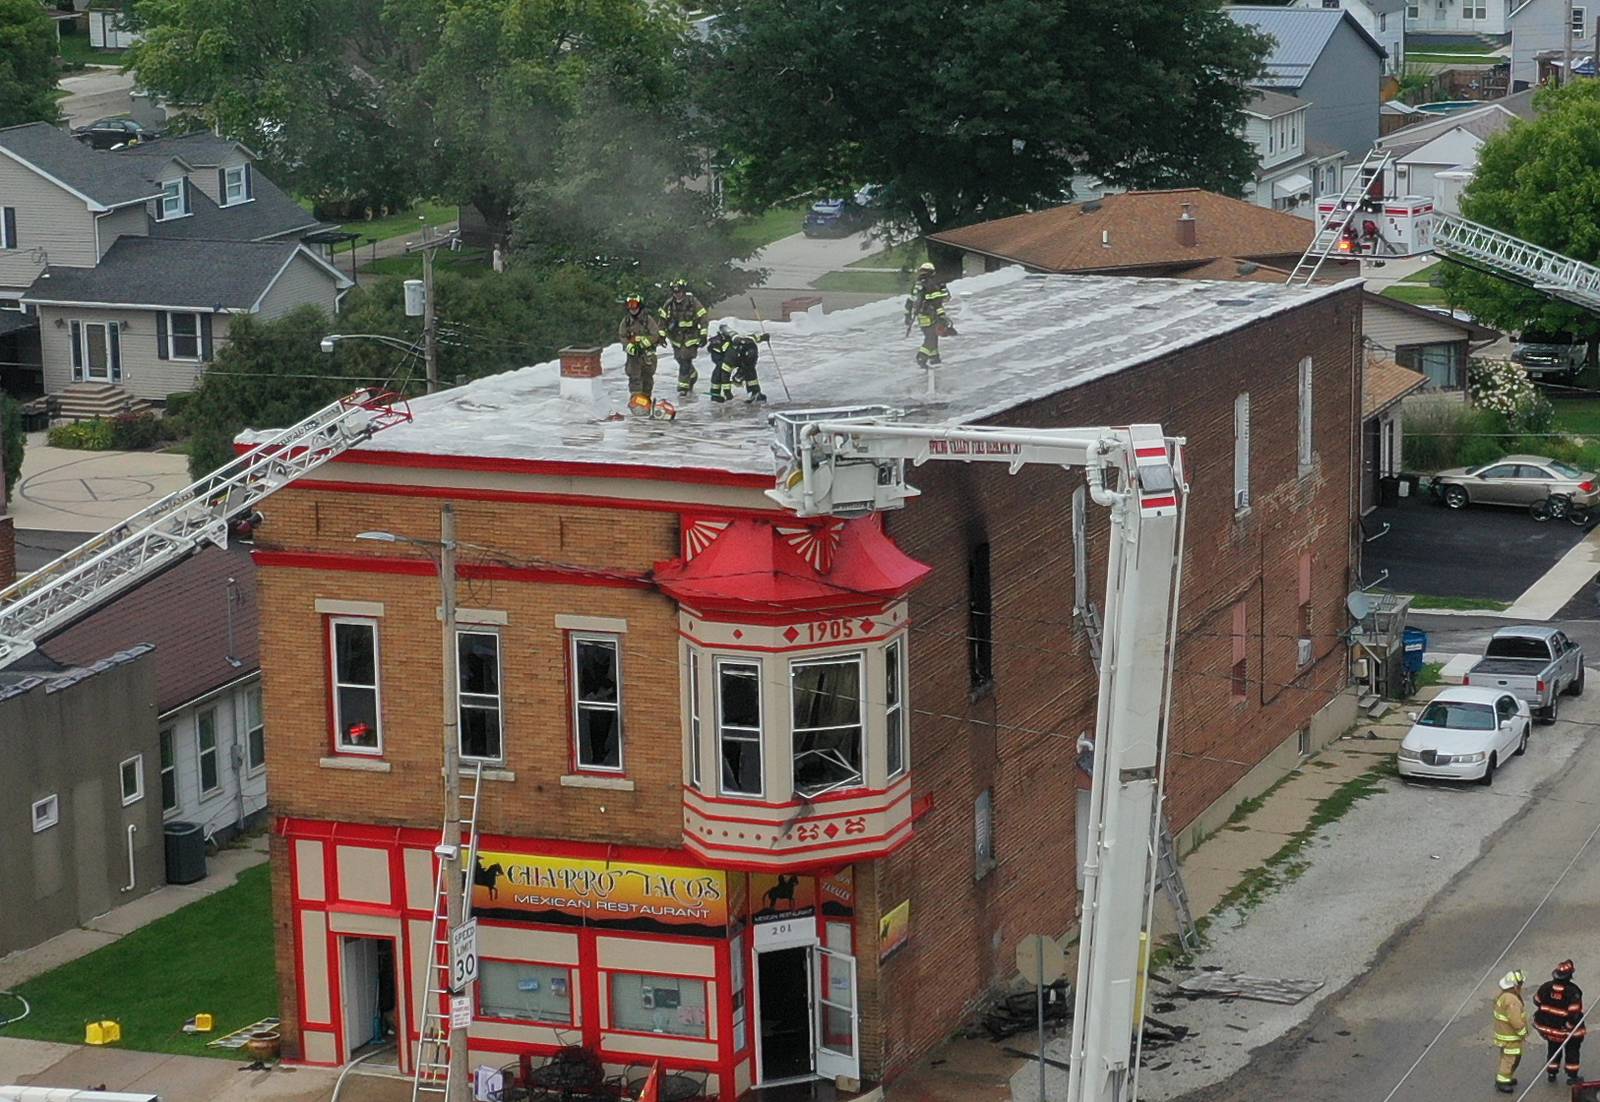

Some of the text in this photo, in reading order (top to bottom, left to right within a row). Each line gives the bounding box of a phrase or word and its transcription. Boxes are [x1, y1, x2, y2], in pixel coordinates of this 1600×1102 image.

[807, 620, 853, 642] 1905
[506, 865, 720, 908] CHARRO TACOS
[514, 894, 710, 918] MEXICAN RESTAURANT
[454, 926, 475, 945] SPEED
[772, 923, 792, 935] 201
[456, 940, 473, 957] LIMIT
[456, 953, 475, 982] 30
